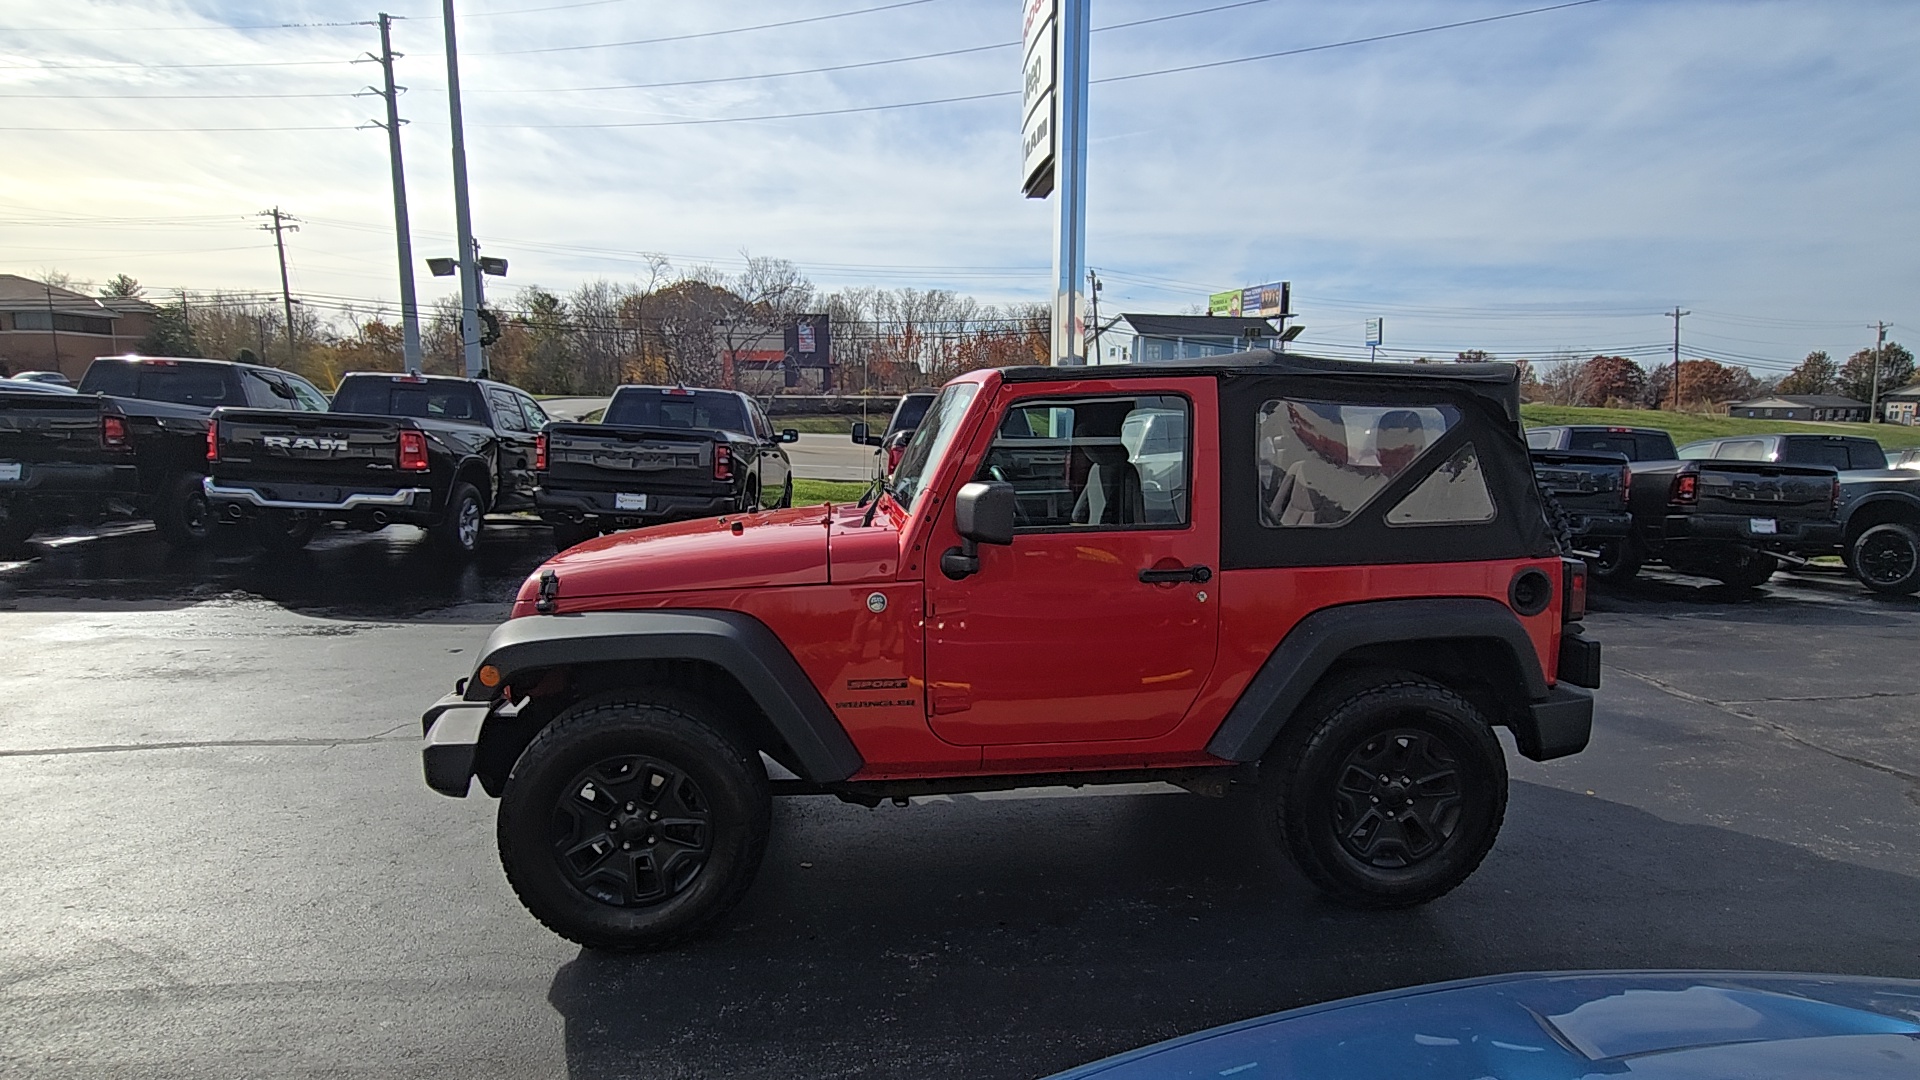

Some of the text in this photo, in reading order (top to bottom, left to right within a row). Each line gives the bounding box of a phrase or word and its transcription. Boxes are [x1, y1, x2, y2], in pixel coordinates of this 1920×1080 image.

[1025, 116, 1047, 162] RAM
[264, 436, 349, 451] RAM
[849, 680, 907, 689] SPORT
[835, 699, 916, 709] WRANGLER
